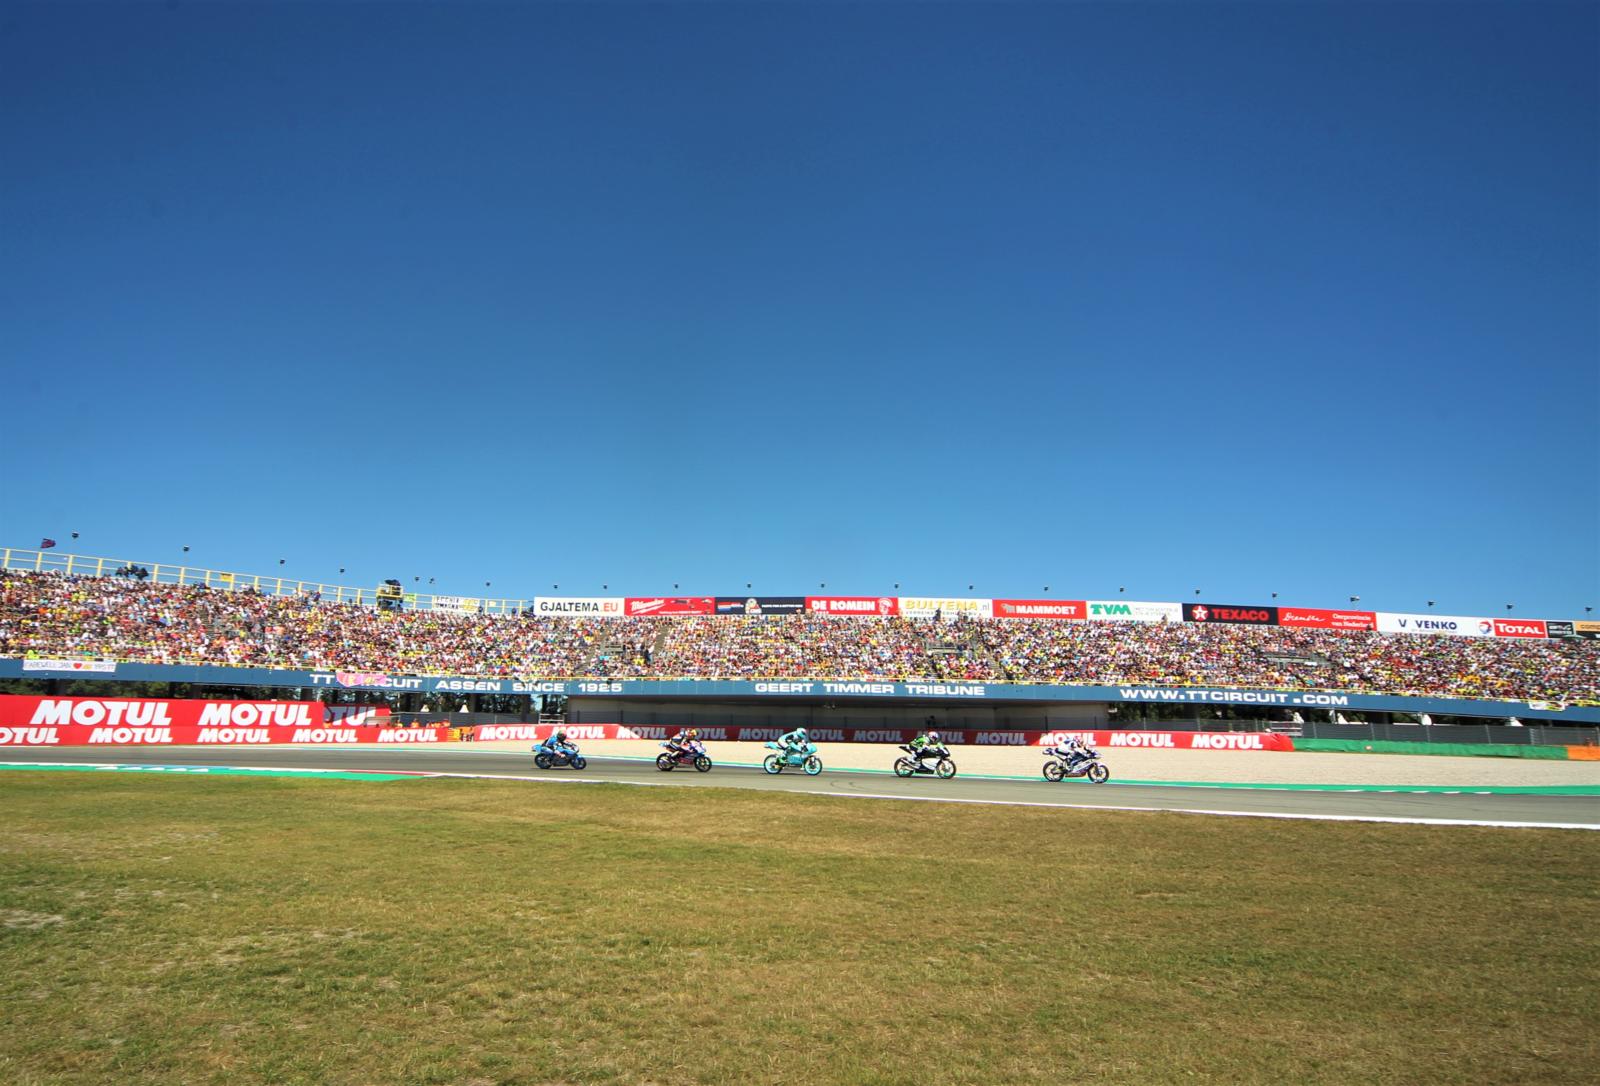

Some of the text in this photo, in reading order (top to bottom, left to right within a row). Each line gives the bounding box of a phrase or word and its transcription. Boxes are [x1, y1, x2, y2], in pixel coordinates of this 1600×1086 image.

[811, 600, 876, 611] DE ROMEIN
[1015, 605, 1077, 614] MAMMOET
[1090, 604, 1132, 615] TVM
[1211, 608, 1270, 621] TEXACO
[1415, 620, 1458, 630] VENKO
[309, 674, 335, 684] TT
[435, 680, 501, 692] ASSEN
[512, 682, 565, 693] SINCE
[578, 683, 622, 693] 1925
[755, 683, 985, 697] GEERT TIMMER TRIBUNE
[30, 700, 172, 726] MOTUL
[197, 703, 312, 726] MOTUL
[0, 727, 438, 744] OTUL MOTUL MOTUL MOTUL MOTUL
[480, 726, 537, 739] MOTUL
[616, 726, 667, 739] MOTUL
[804, 729, 845, 741] OTUL
[853, 730, 903, 742] MOTUL
[975, 732, 1027, 745] MOTUL
[1110, 733, 1174, 747] MOTUL
[1191, 735, 1263, 749] MOTUL
